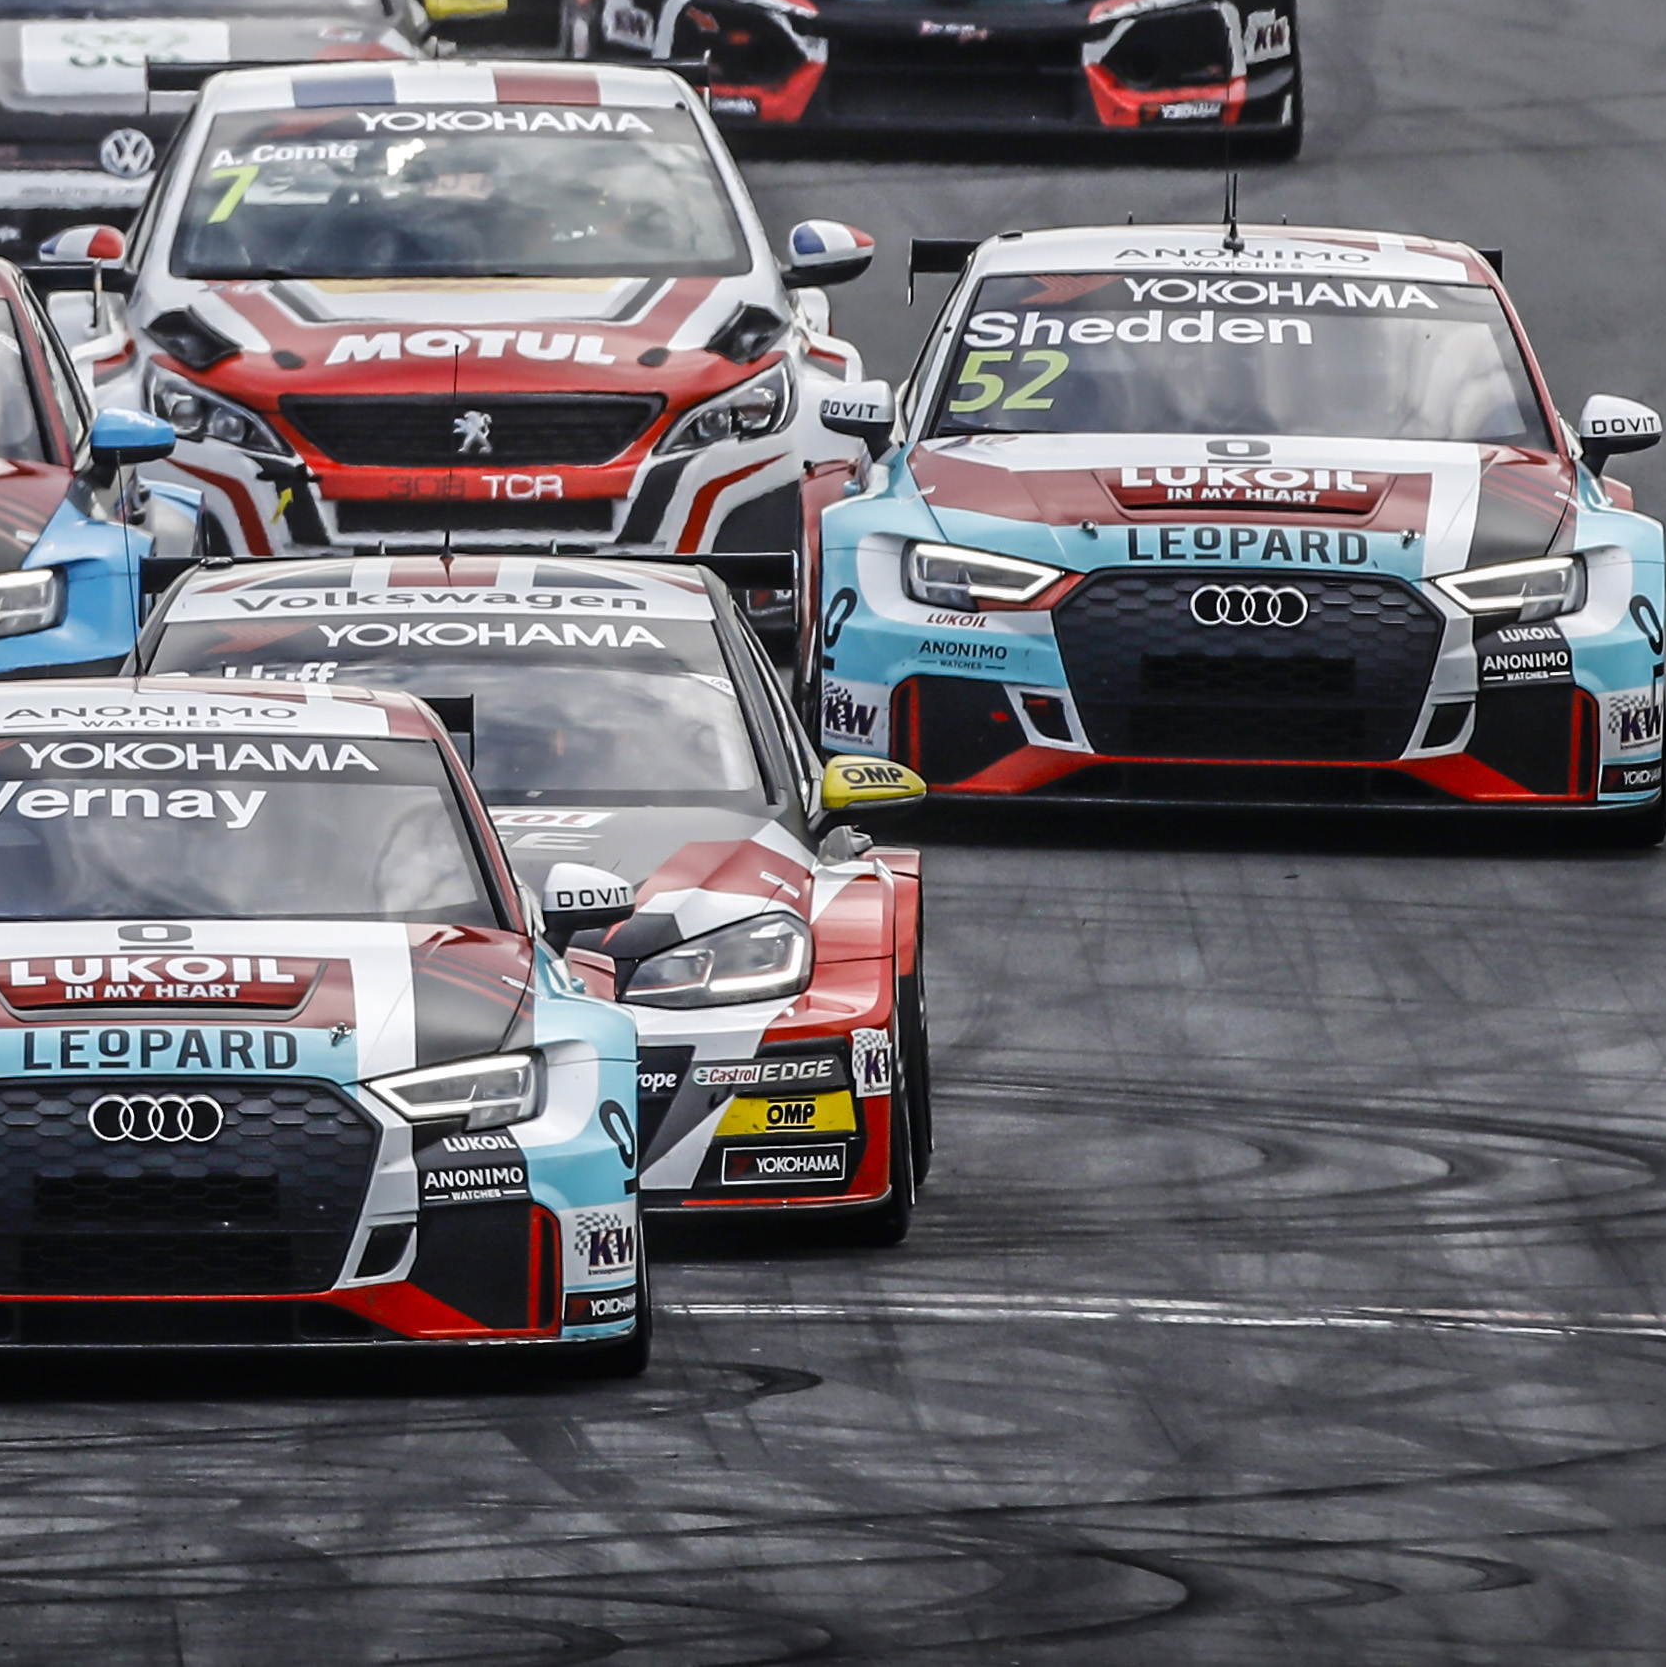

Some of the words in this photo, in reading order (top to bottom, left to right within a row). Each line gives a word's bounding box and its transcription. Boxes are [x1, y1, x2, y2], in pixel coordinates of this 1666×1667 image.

[356, 112, 653, 134] YOKOHAMA
[212, 146, 241, 168] A.
[208, 166, 259, 224] 7
[1115, 248, 1370, 263] ANONIMO
[1183, 261, 1303, 269] WATCHES
[1124, 277, 1438, 310] YOKOHAMA
[964, 310, 1313, 347] Shedden
[324, 330, 617, 366] MOTUL
[949, 349, 1069, 412] 52
[821, 399, 879, 419] DOVIT
[1592, 417, 1654, 434] DOVIT
[482, 473, 563, 500] TCR
[1120, 467, 1367, 492] LUKOIL
[1167, 487, 1195, 501] IN
[1202, 488, 1238, 502] MY
[1246, 489, 1320, 504] HEART
[1128, 526, 1367, 564] LEOPARD
[233, 589, 647, 613] Volkswagen
[926, 613, 988, 628] LUKOIL
[318, 622, 665, 649] YOKOHAMA
[1497, 627, 1561, 643] LUKOIL
[919, 640, 1007, 659] ANONIMO
[940, 660, 982, 670] WATCHES
[1483, 651, 1568, 671] ANONIMO
[1507, 670, 1549, 681] WATCHES
[4, 705, 298, 720] ANONIMO
[81, 719, 220, 728] WATCHES
[824, 698, 878, 736] KW
[1620, 705, 1662, 743] KW
[20, 743, 378, 771] YOKOHAMA
[842, 766, 904, 784] OMP
[556, 886, 629, 909] DOVIT
[7, 956, 298, 985] LUKOIL
[65, 985, 95, 999] IN
[103, 985, 147, 1000] MY
[155, 984, 239, 999] HEART
[23, 1028, 298, 1070] LEOPARD
[637, 1069, 677, 1090] rope
[709, 1064, 758, 1084] Castrol
[761, 1059, 834, 1083] EDGE
[766, 1102, 816, 1125] OMP
[443, 1135, 516, 1153] LUKOIL
[755, 1153, 840, 1174] YOKOHAMA
[424, 1166, 524, 1190] ANONIMO
[452, 1189, 501, 1200] WATCHES
[589, 1225, 636, 1267] KW
